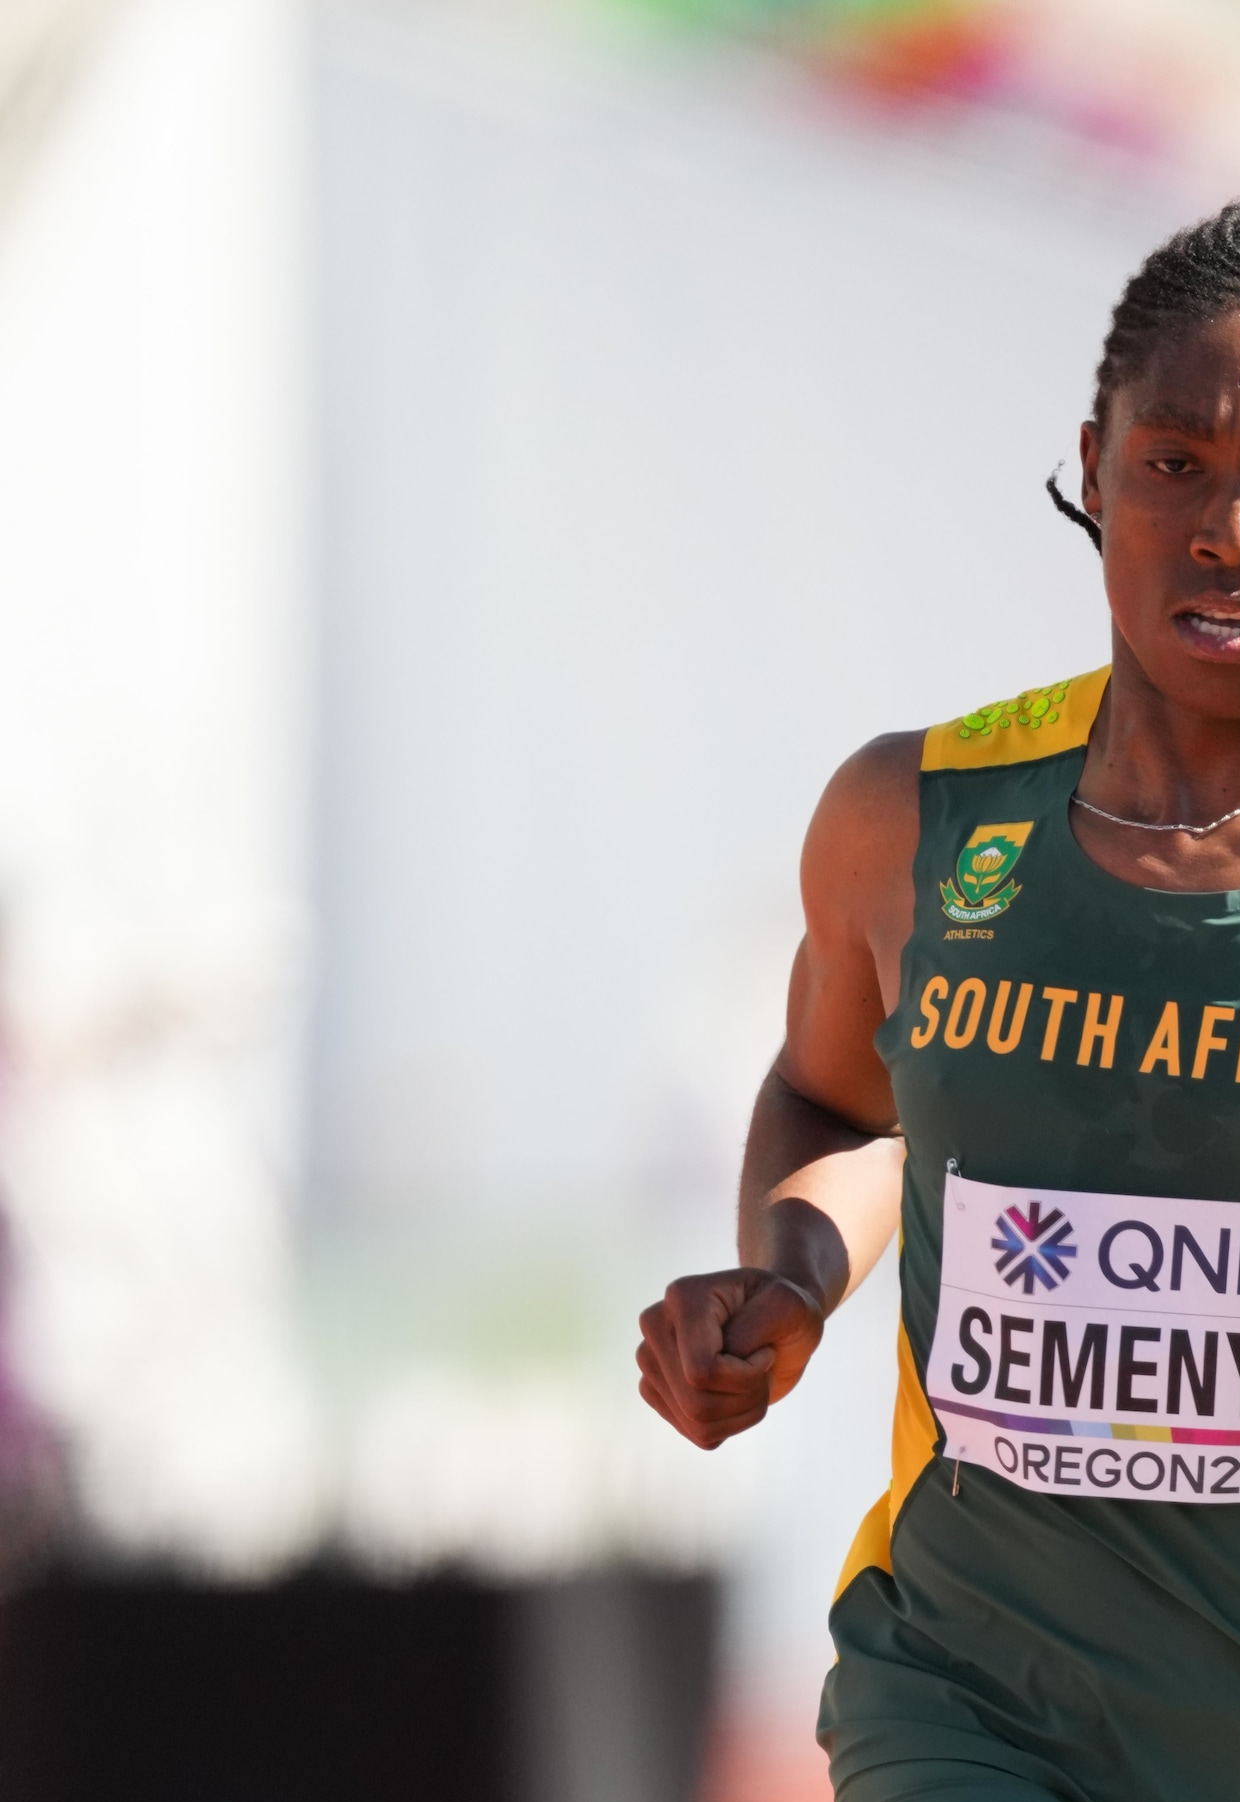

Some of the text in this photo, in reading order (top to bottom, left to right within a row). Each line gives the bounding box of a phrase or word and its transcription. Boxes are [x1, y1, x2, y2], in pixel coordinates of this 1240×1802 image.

[948, 903, 1002, 920] SOUTH AFRICA
[943, 928, 995, 941] ATHLETICS
[911, 975, 1124, 1069] SOUTH
